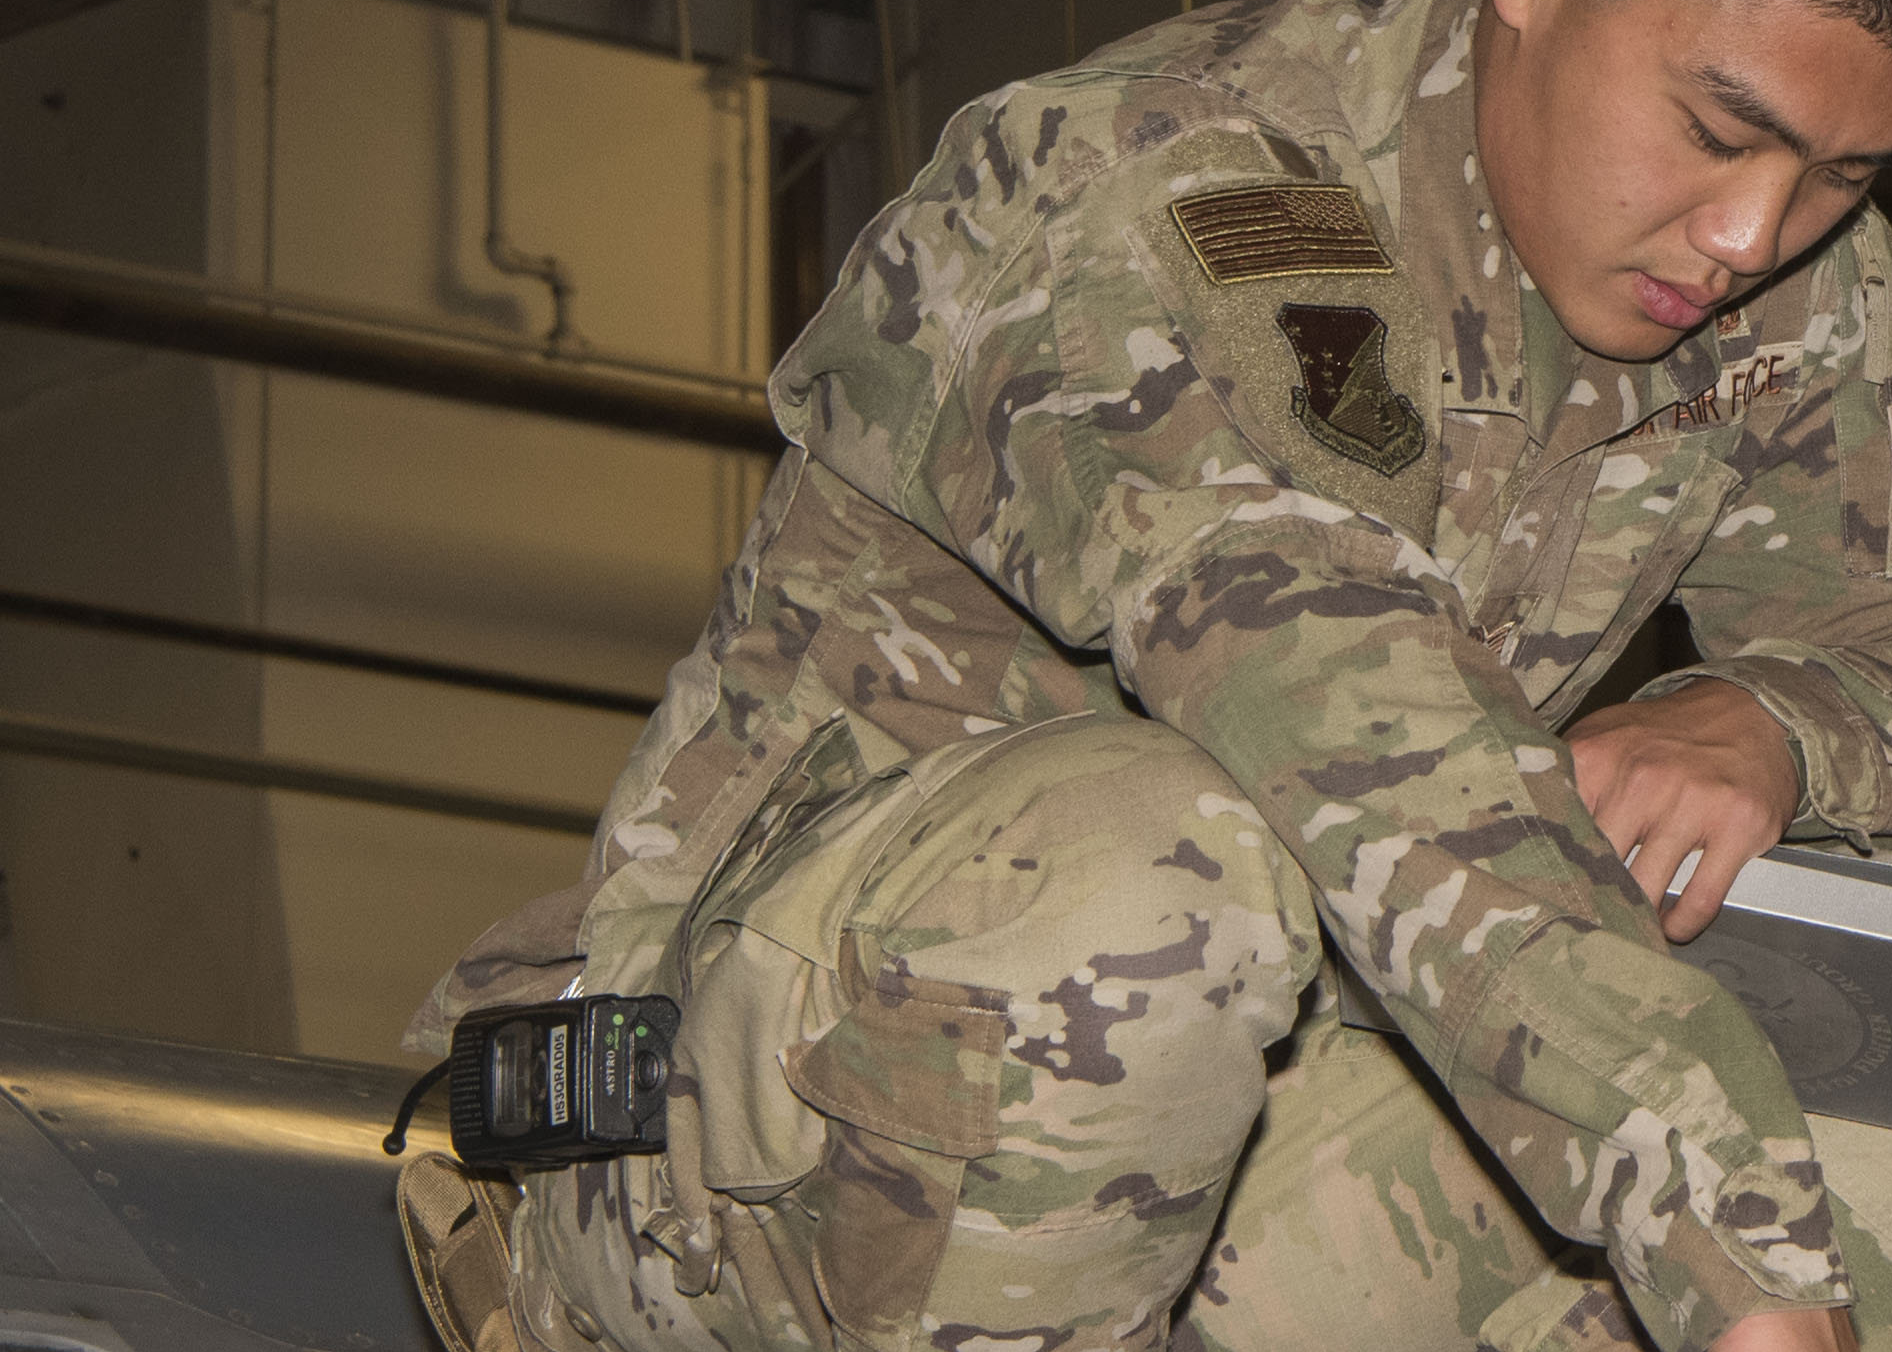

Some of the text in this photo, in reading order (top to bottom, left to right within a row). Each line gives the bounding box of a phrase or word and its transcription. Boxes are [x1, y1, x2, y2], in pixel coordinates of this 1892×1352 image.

[1672, 354, 1786, 429] AIR FOCE
[552, 1032, 566, 1122] HS3QRAD05
[604, 1049, 616, 1096] ASTRO
